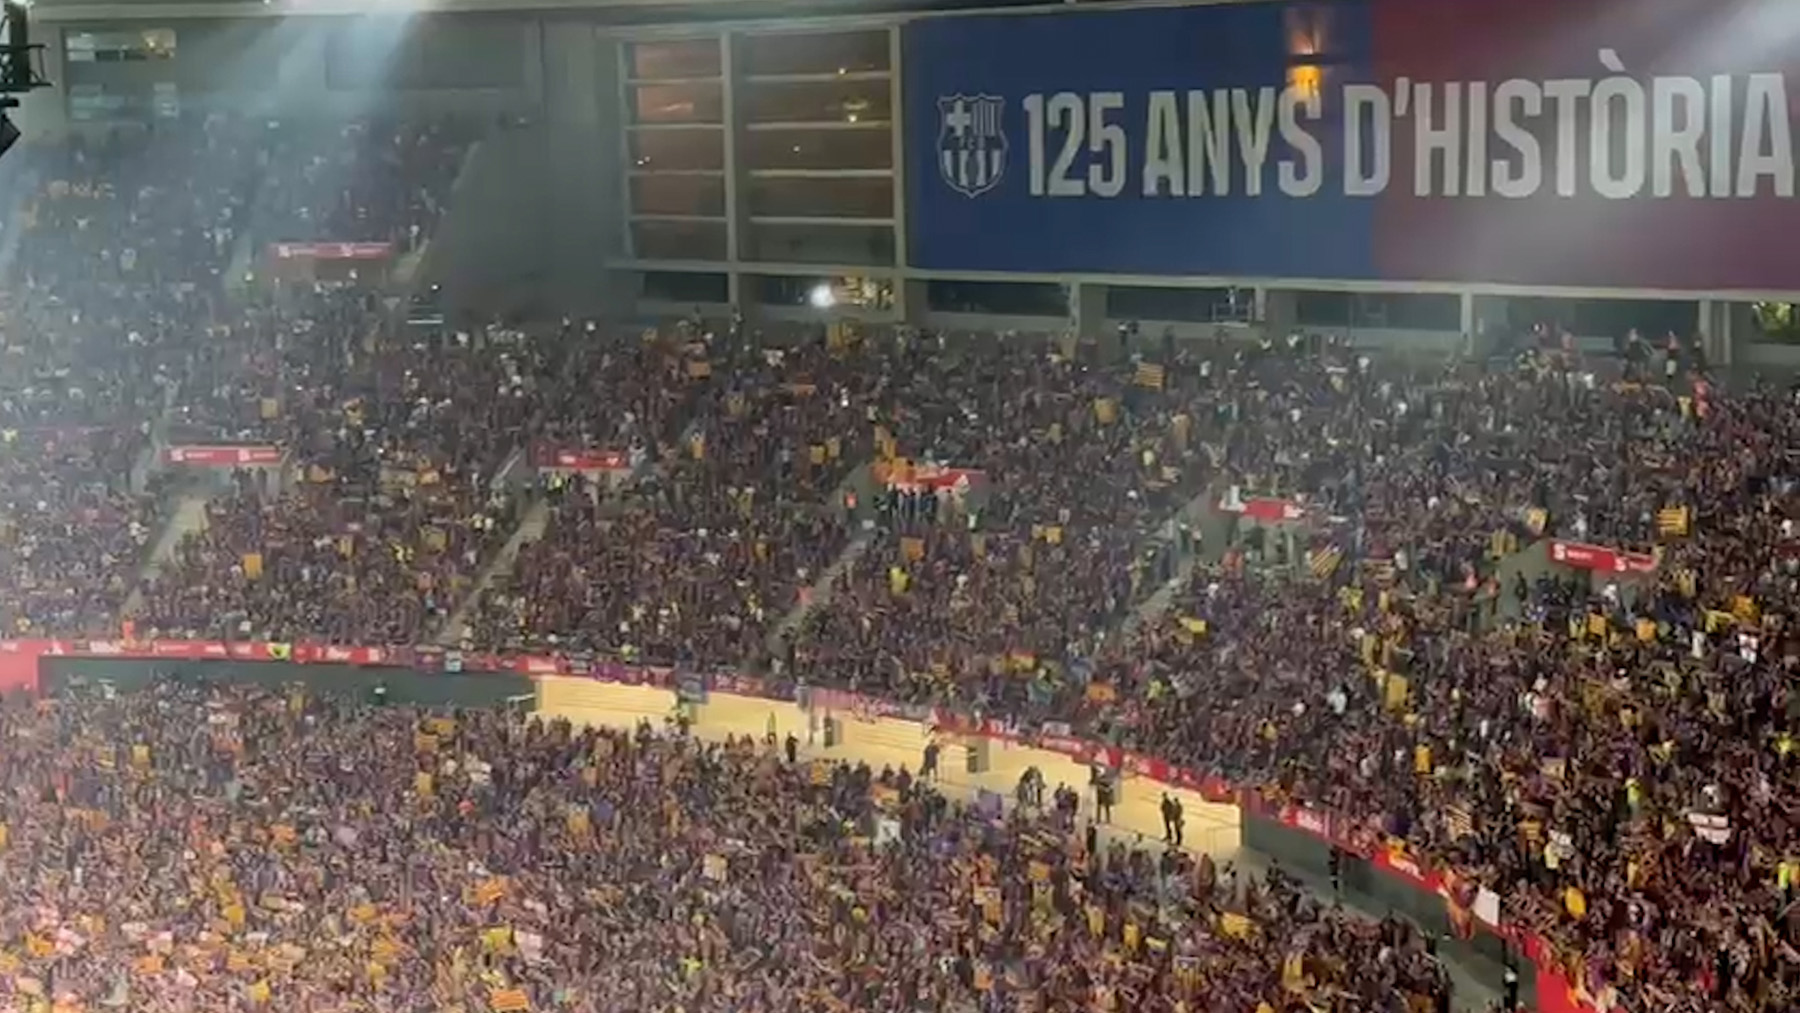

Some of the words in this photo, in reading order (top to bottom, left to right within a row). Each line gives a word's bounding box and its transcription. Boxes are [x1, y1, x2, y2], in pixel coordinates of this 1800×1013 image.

[1023, 92, 1126, 197] 125
[1143, 86, 1323, 197] ANYS
[1343, 48, 1794, 199] D'HISTÒRIA
